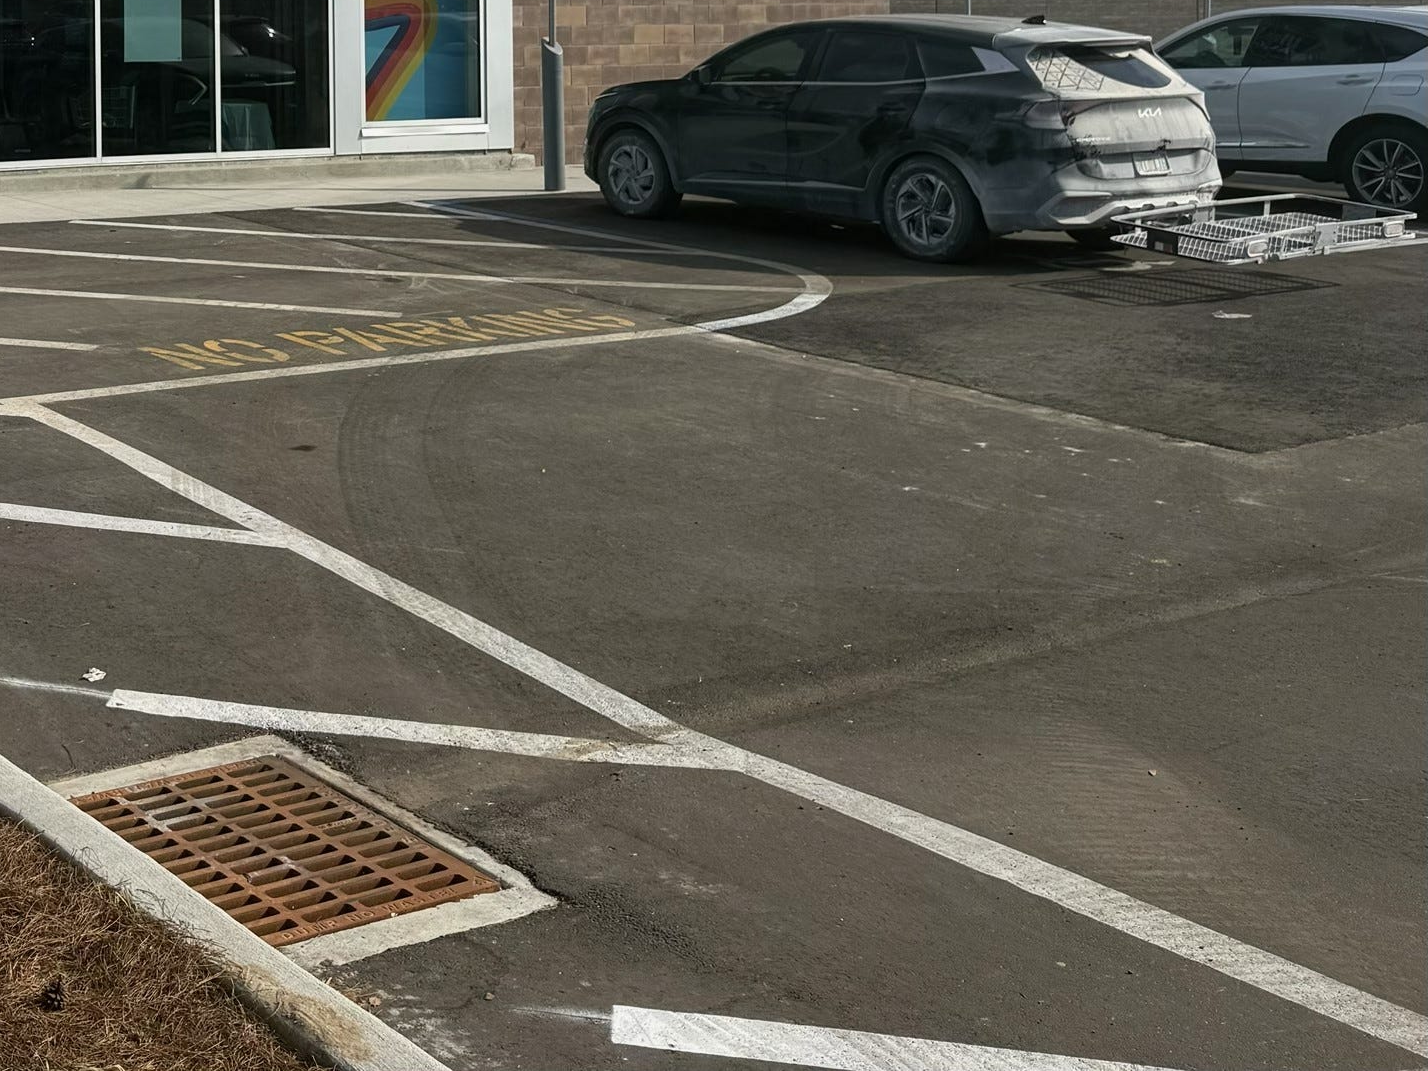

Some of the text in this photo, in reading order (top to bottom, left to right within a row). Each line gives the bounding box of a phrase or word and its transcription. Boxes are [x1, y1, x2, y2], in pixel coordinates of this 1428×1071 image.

[1137, 107, 1162, 119] KIA
[137, 308, 637, 370] NO PARKING
[347, 910, 376, 923] NO
